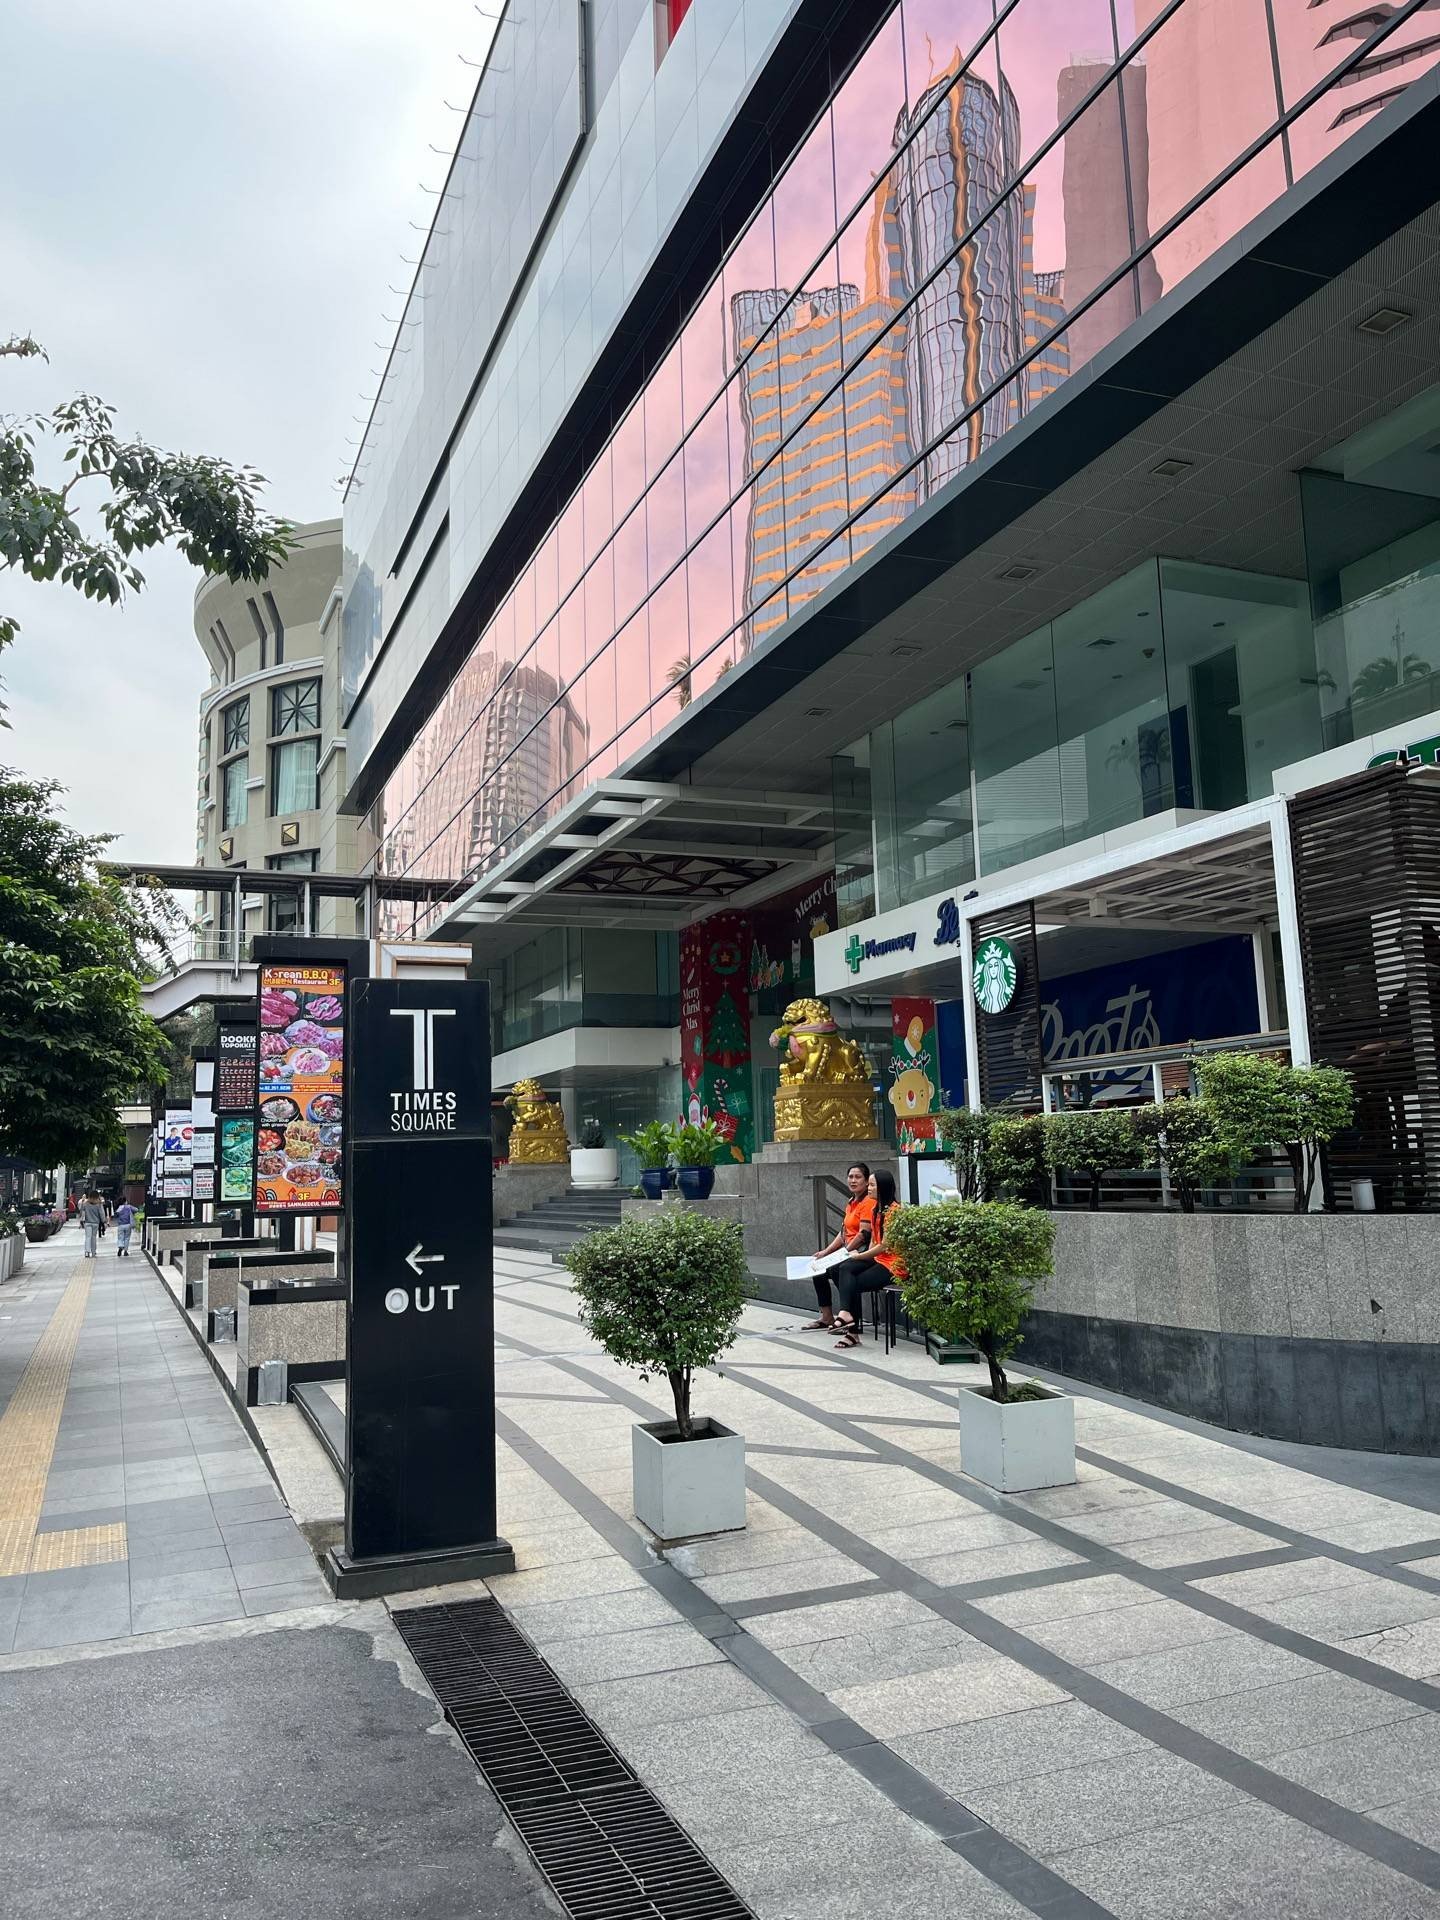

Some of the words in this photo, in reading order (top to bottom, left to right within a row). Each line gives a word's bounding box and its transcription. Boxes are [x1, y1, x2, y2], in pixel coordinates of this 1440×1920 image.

[793, 887, 823, 924] Merry
[864, 931, 917, 959] Pharmacy
[264, 968, 302, 979] Korean
[329, 978, 342, 986] 3F
[682, 987, 700, 1000] Merry
[390, 1092, 457, 1111] TIMES
[391, 1112, 457, 1132] SQUARE
[297, 1192, 310, 1200] 3F
[384, 1284, 461, 1314] OUT
